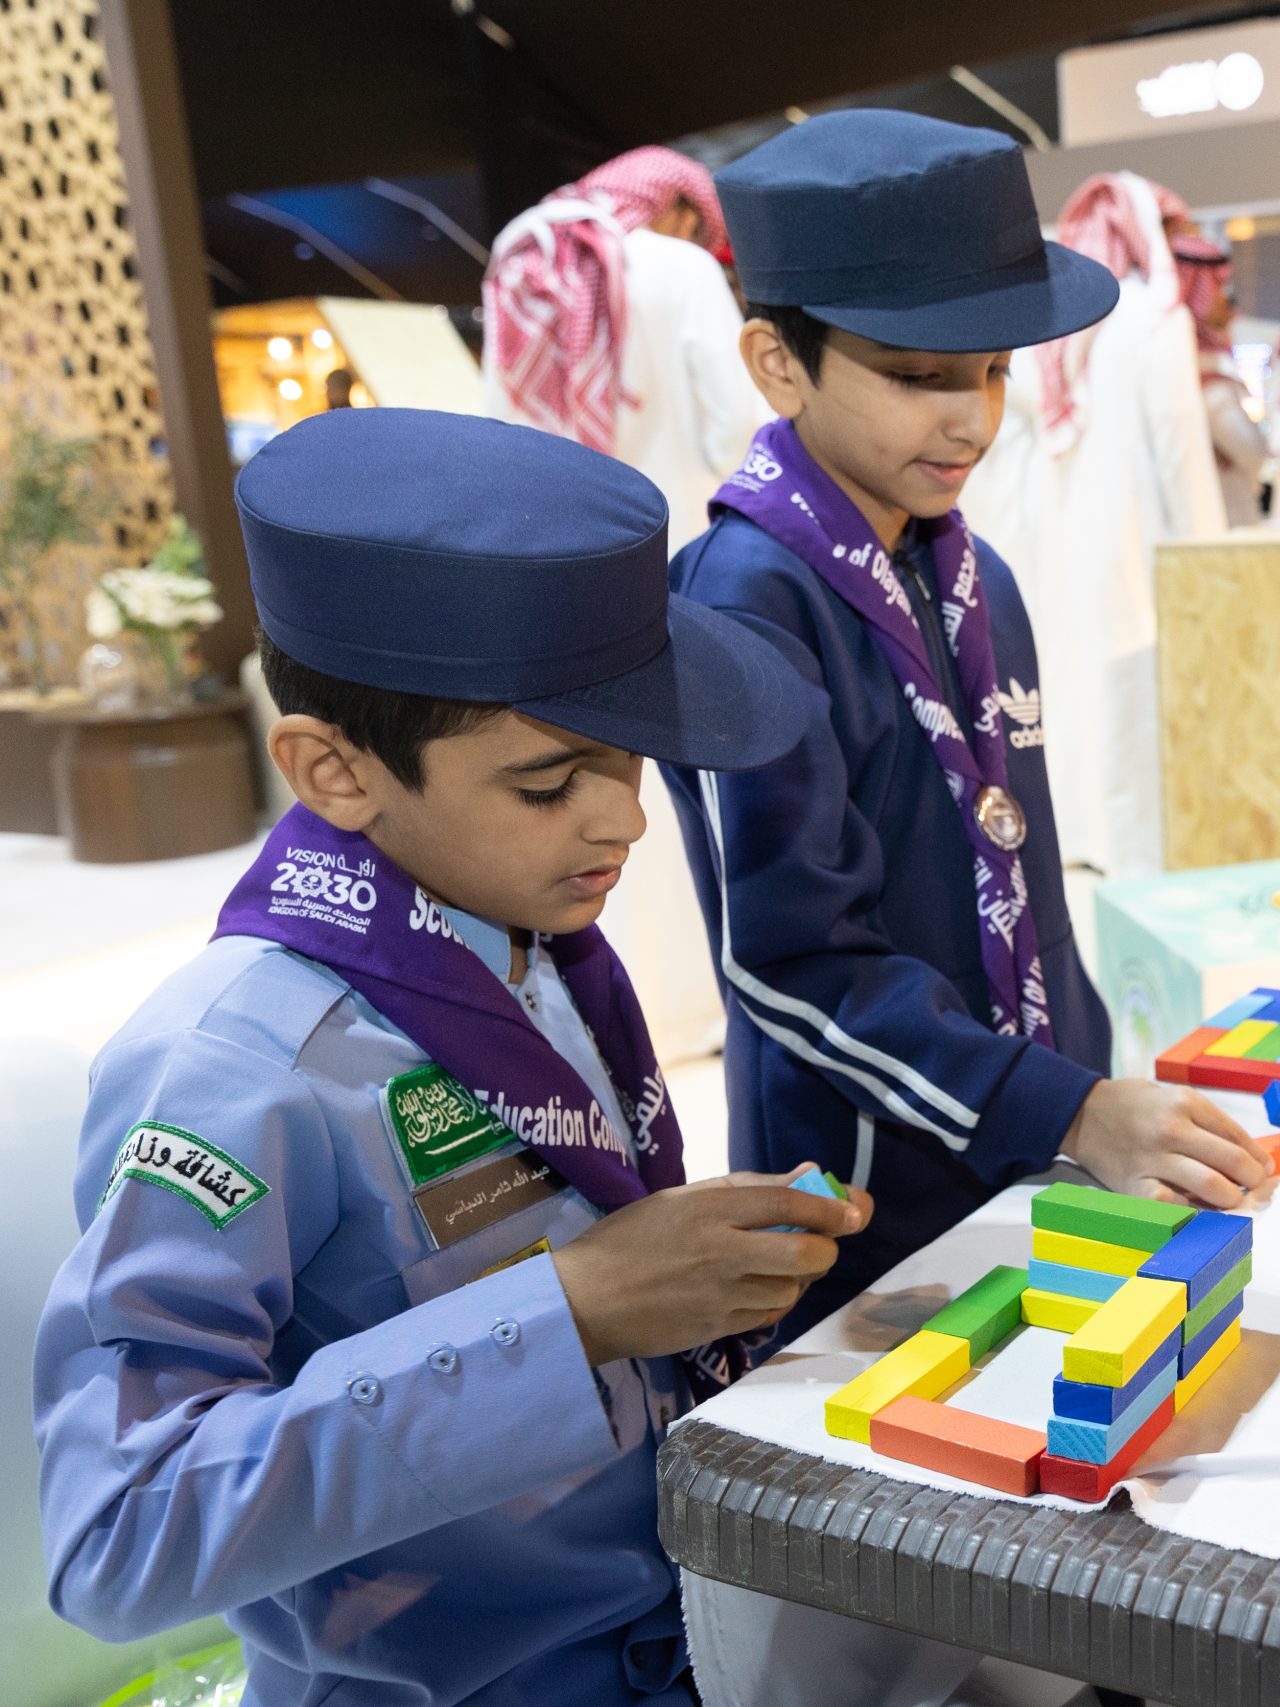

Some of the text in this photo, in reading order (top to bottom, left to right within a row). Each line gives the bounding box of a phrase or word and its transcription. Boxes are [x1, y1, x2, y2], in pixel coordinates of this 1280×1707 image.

[848, 542, 873, 567] of
[286, 846, 336, 868] VISION
[308, 910, 336, 924] SAUDI
[335, 918, 367, 935] ARABIA
[174, 1149, 247, 1208] كشافة
